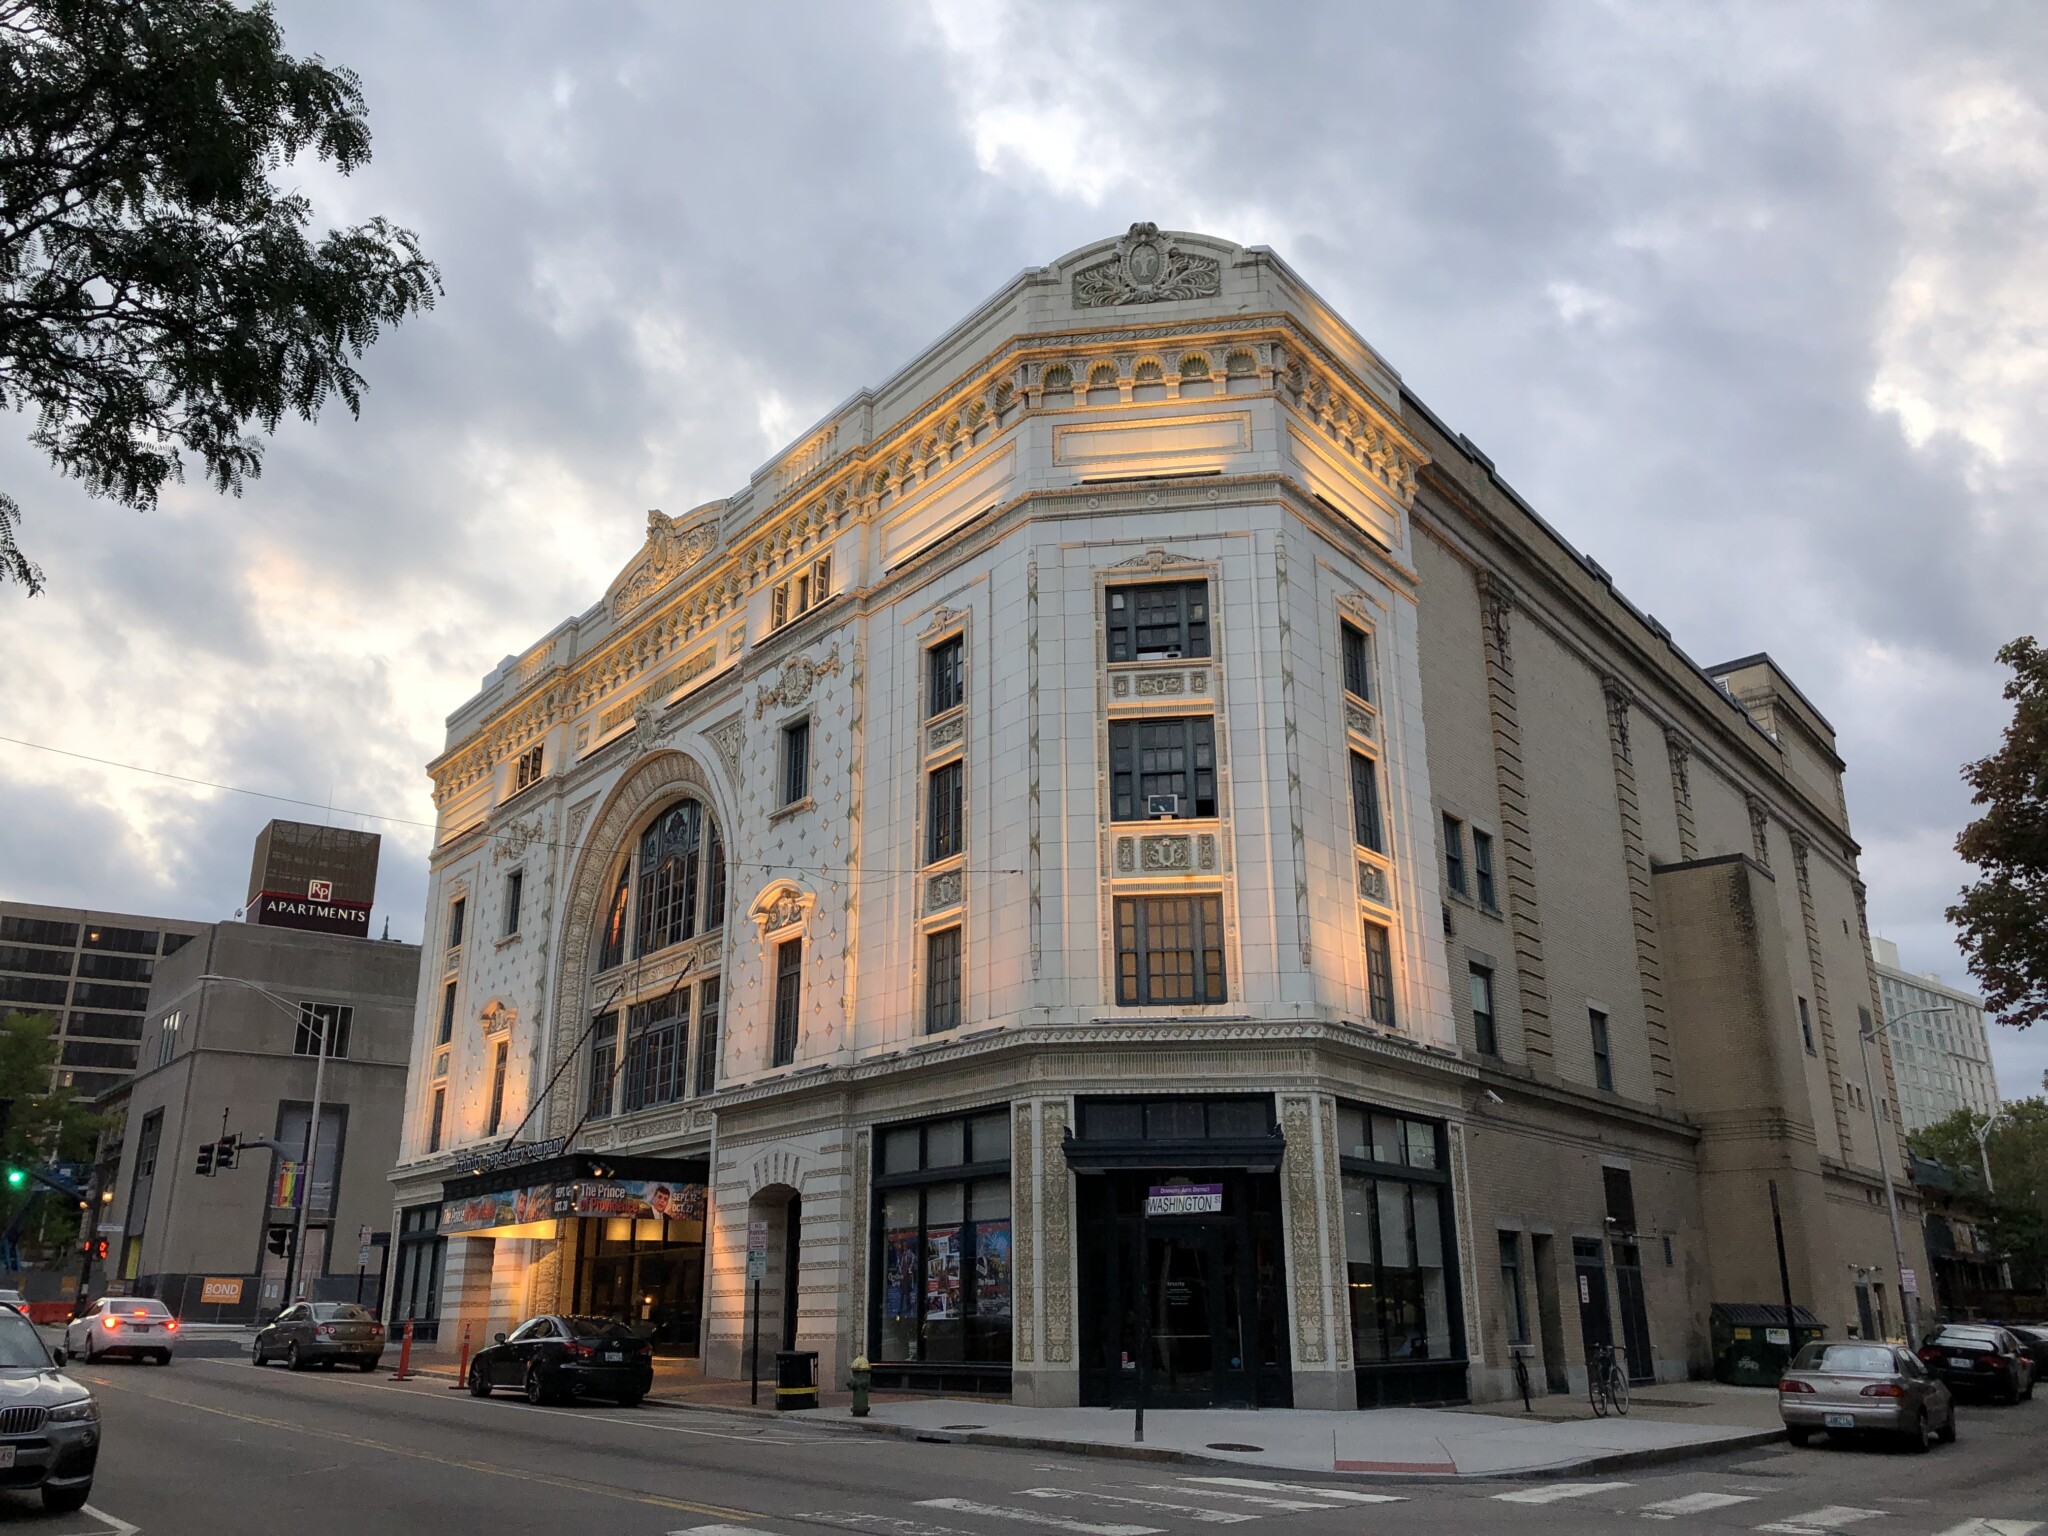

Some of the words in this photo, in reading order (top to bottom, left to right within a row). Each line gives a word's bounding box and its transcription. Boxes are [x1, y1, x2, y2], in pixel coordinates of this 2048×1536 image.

[267, 901, 366, 922] APARTMENTS
[456, 1154, 482, 1173] trinity
[486, 1146, 525, 1168] repertory
[527, 1136, 566, 1160] company
[580, 1183, 596, 1197] The
[597, 1183, 626, 1199] Prince
[673, 1192, 689, 1202] SEPT.
[580, 1198, 590, 1210] of
[592, 1199, 638, 1212] Providence
[672, 1204, 686, 1212] OCT.
[686, 1204, 694, 1212] 27
[1149, 1196, 1213, 1212] WASHINGTON
[205, 1283, 239, 1295] BOND
